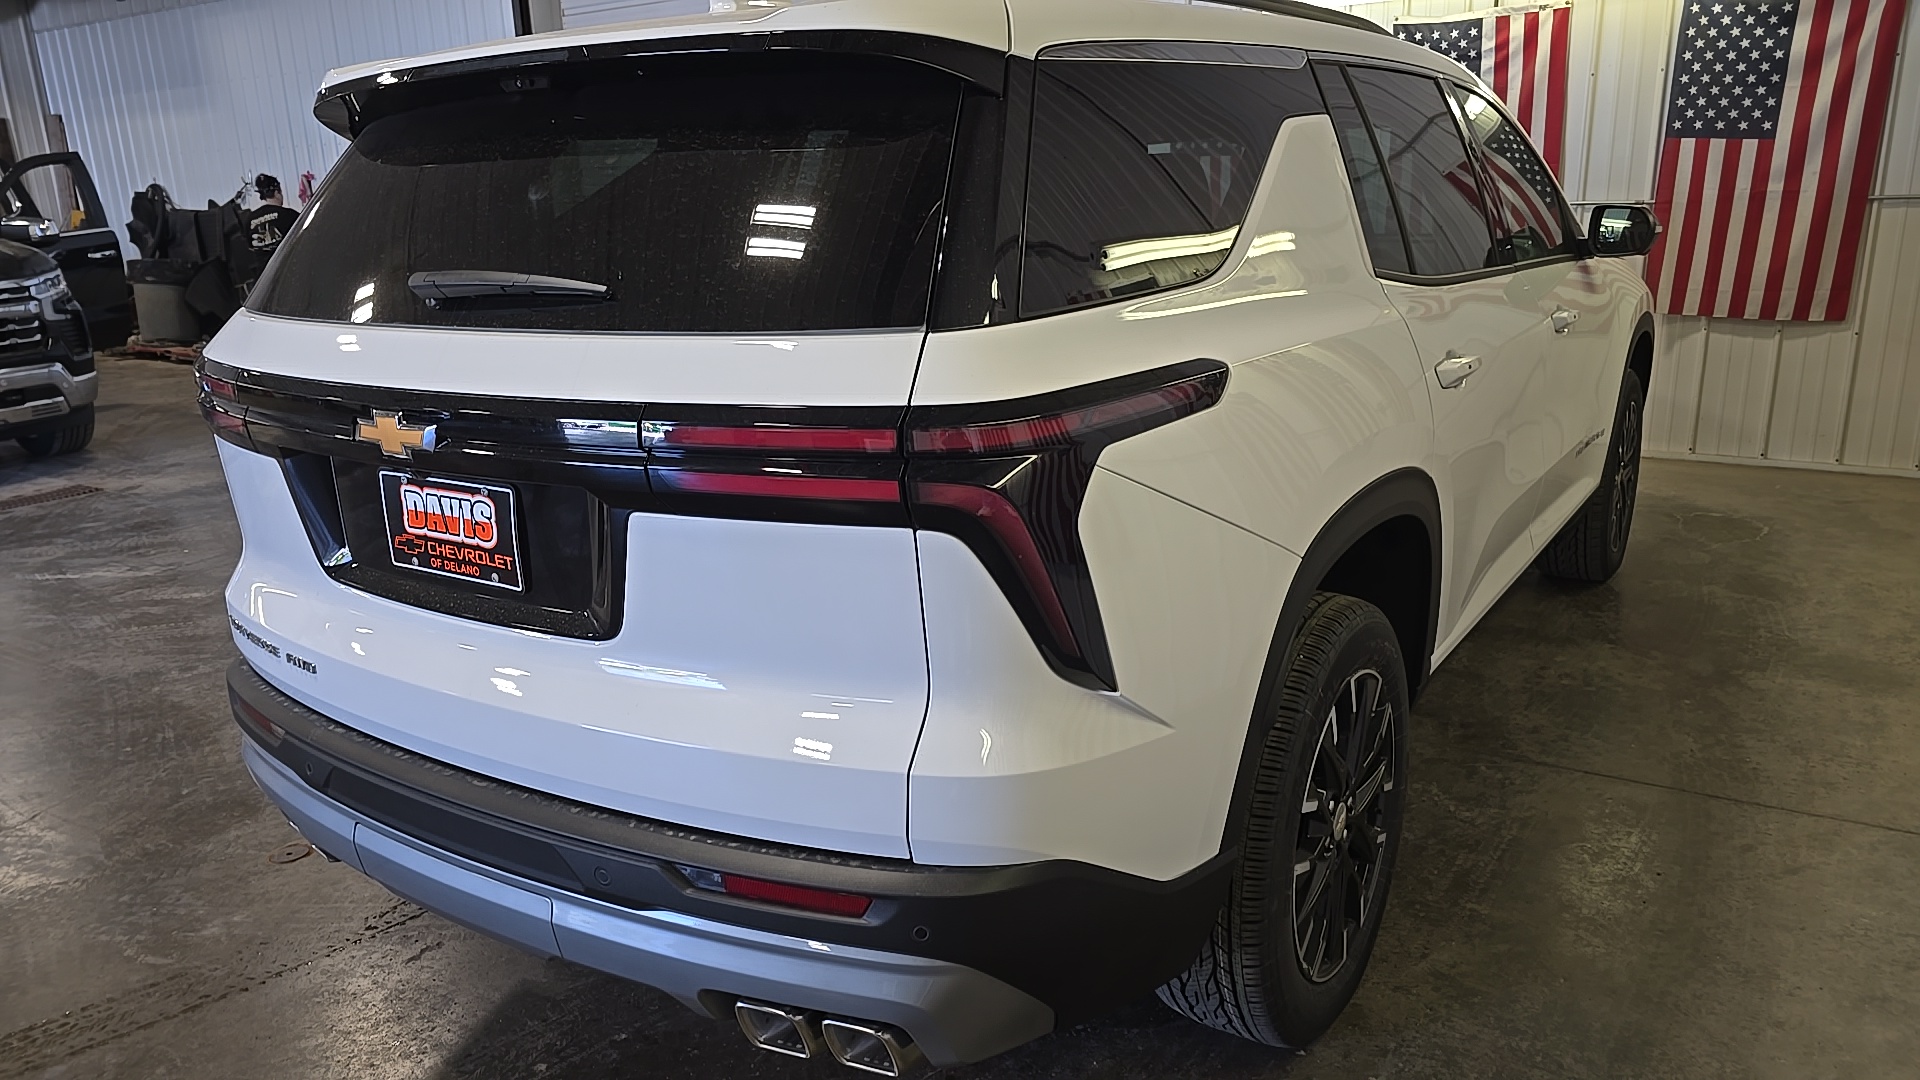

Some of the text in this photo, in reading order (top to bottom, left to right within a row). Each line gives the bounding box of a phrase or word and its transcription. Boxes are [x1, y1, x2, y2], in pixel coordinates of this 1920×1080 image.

[403, 489, 494, 542] DAVIS
[427, 541, 513, 571] CHEVROLET
[430, 557, 480, 576] OF DELANO
